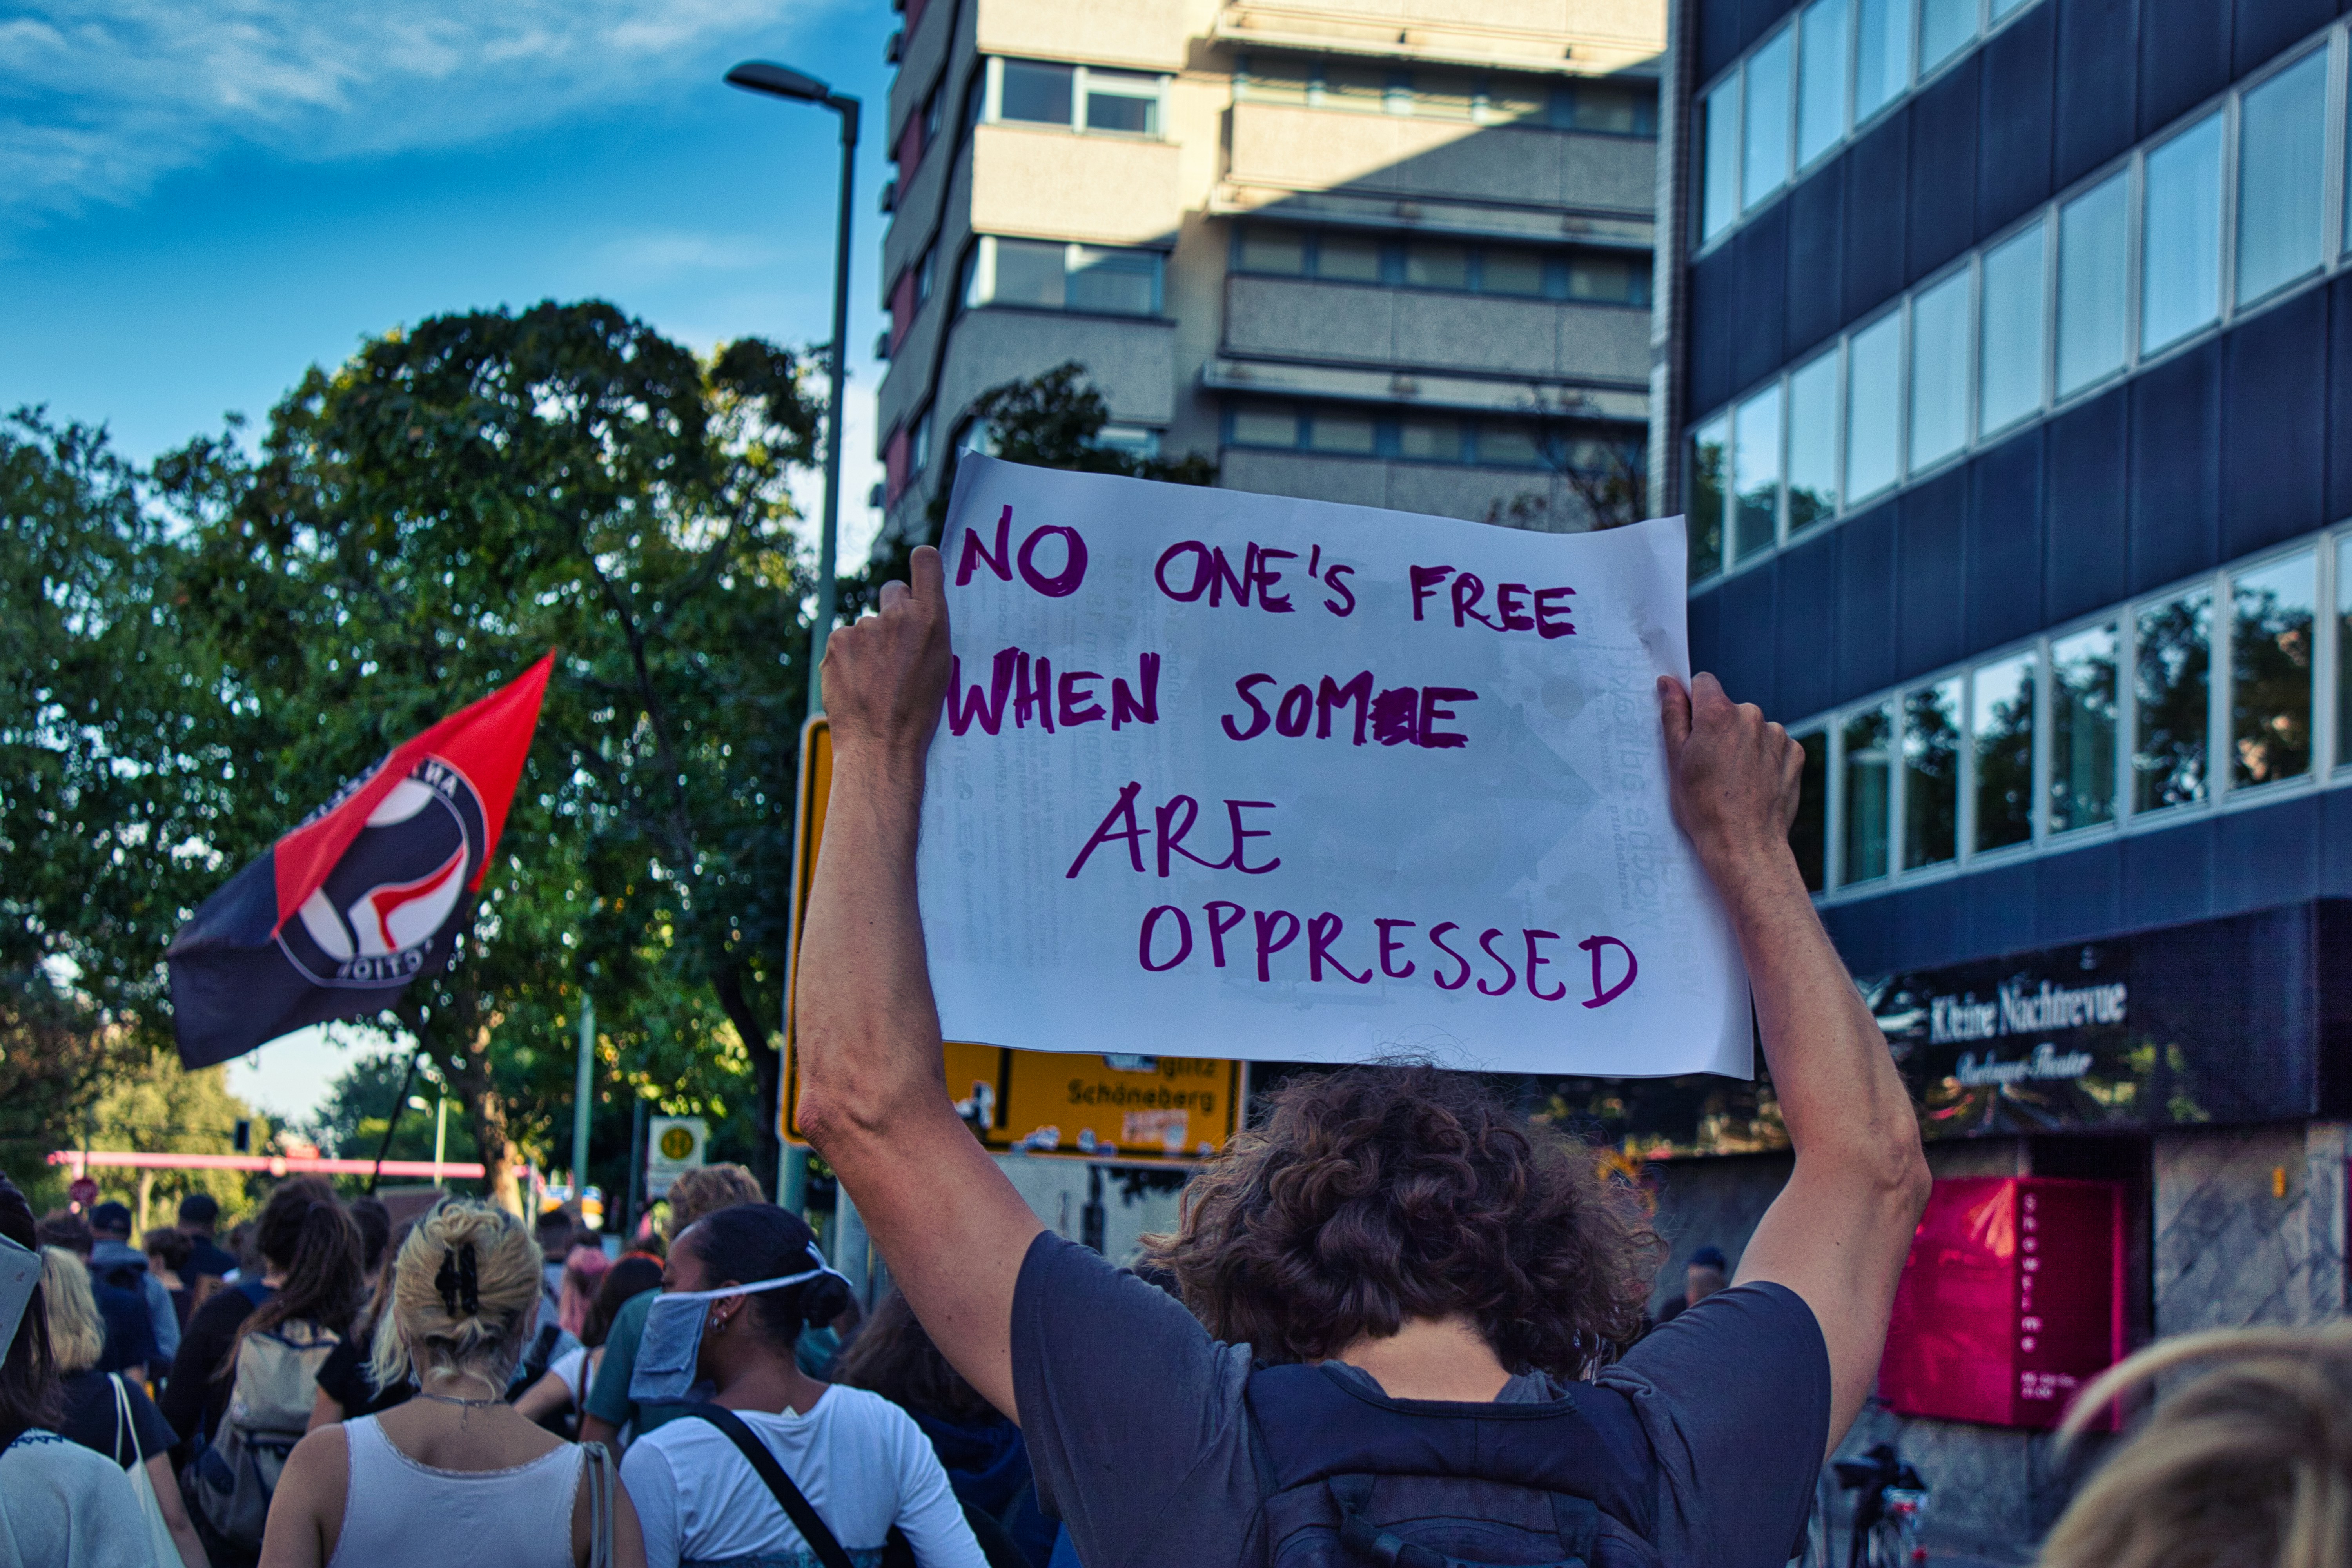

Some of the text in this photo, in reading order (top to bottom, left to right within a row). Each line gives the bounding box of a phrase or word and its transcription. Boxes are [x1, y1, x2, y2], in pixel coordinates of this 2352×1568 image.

[955, 505, 1576, 639] NO ONE'S FREE
[946, 647, 1160, 736] WHEN
[1067, 782, 1280, 878] ARE
[1139, 901, 1637, 1009] OPPRESSED
[1931, 978, 2127, 1045] Kleine Nachtrevue
[1068, 1079, 1215, 1115] Schöneberg
